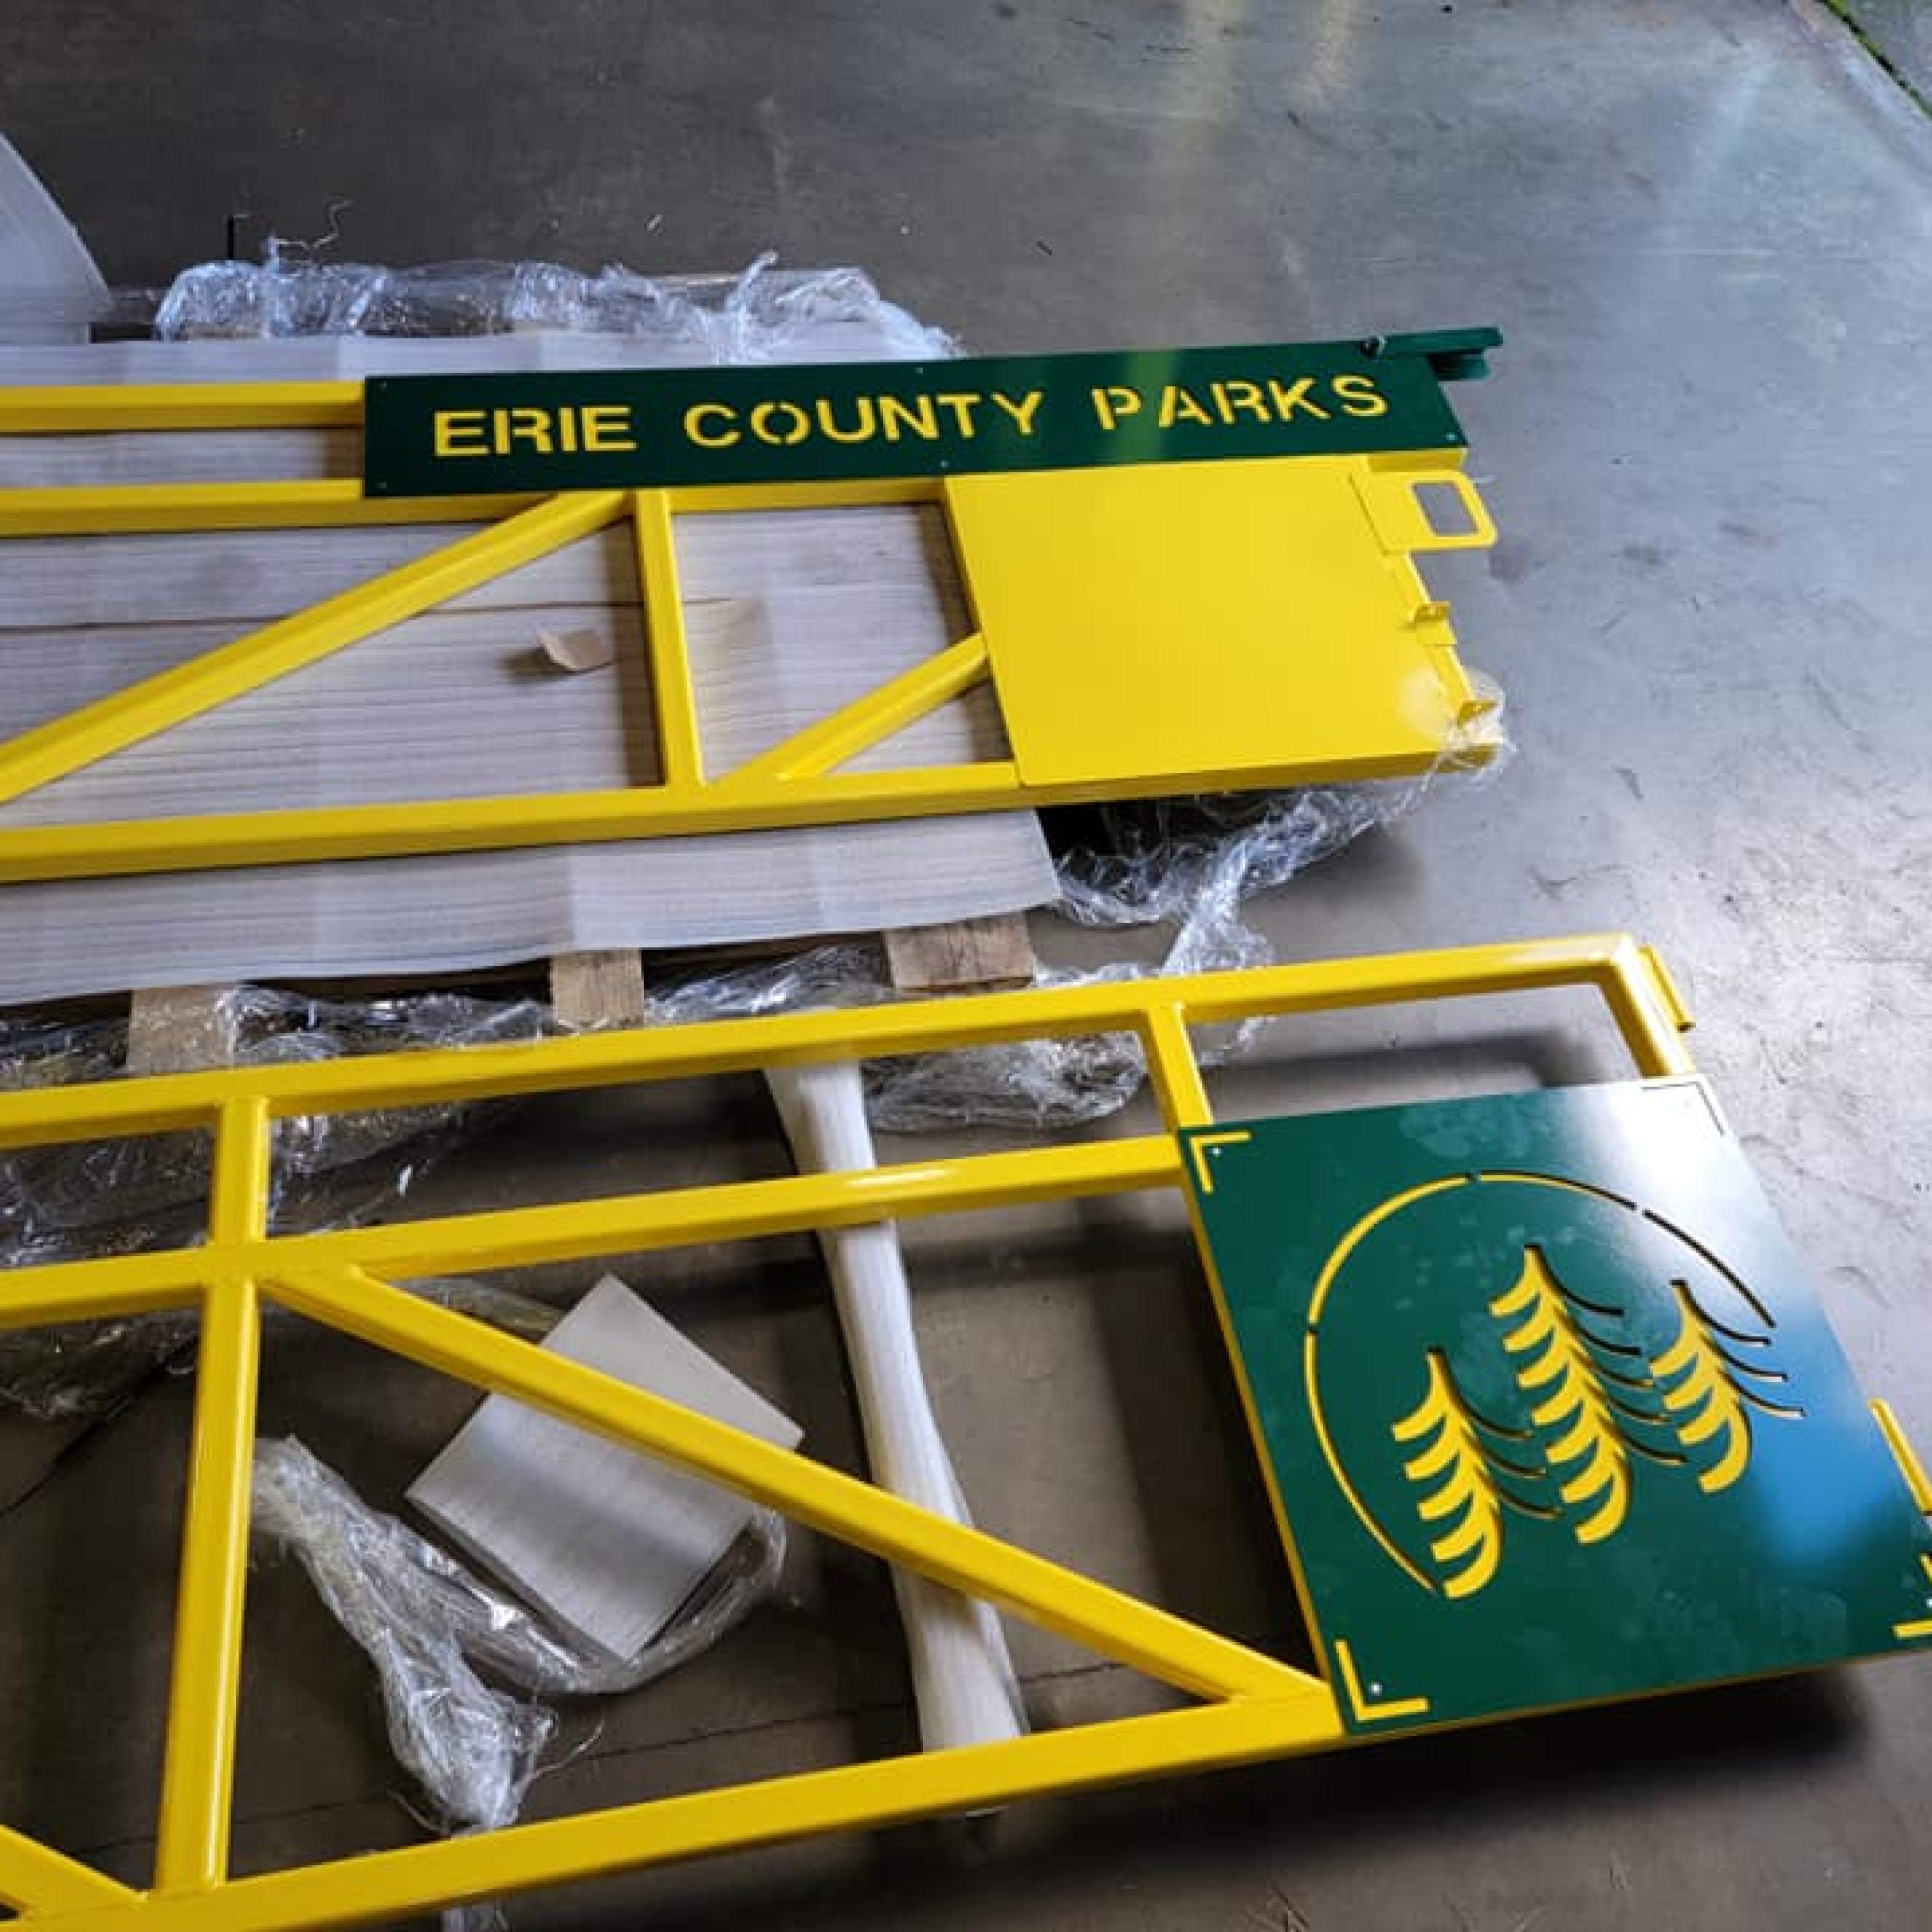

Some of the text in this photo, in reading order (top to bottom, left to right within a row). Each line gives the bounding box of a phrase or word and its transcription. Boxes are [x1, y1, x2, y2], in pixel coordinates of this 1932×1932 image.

[434, 374, 1388, 457] ERIE COUNTY PARKS
